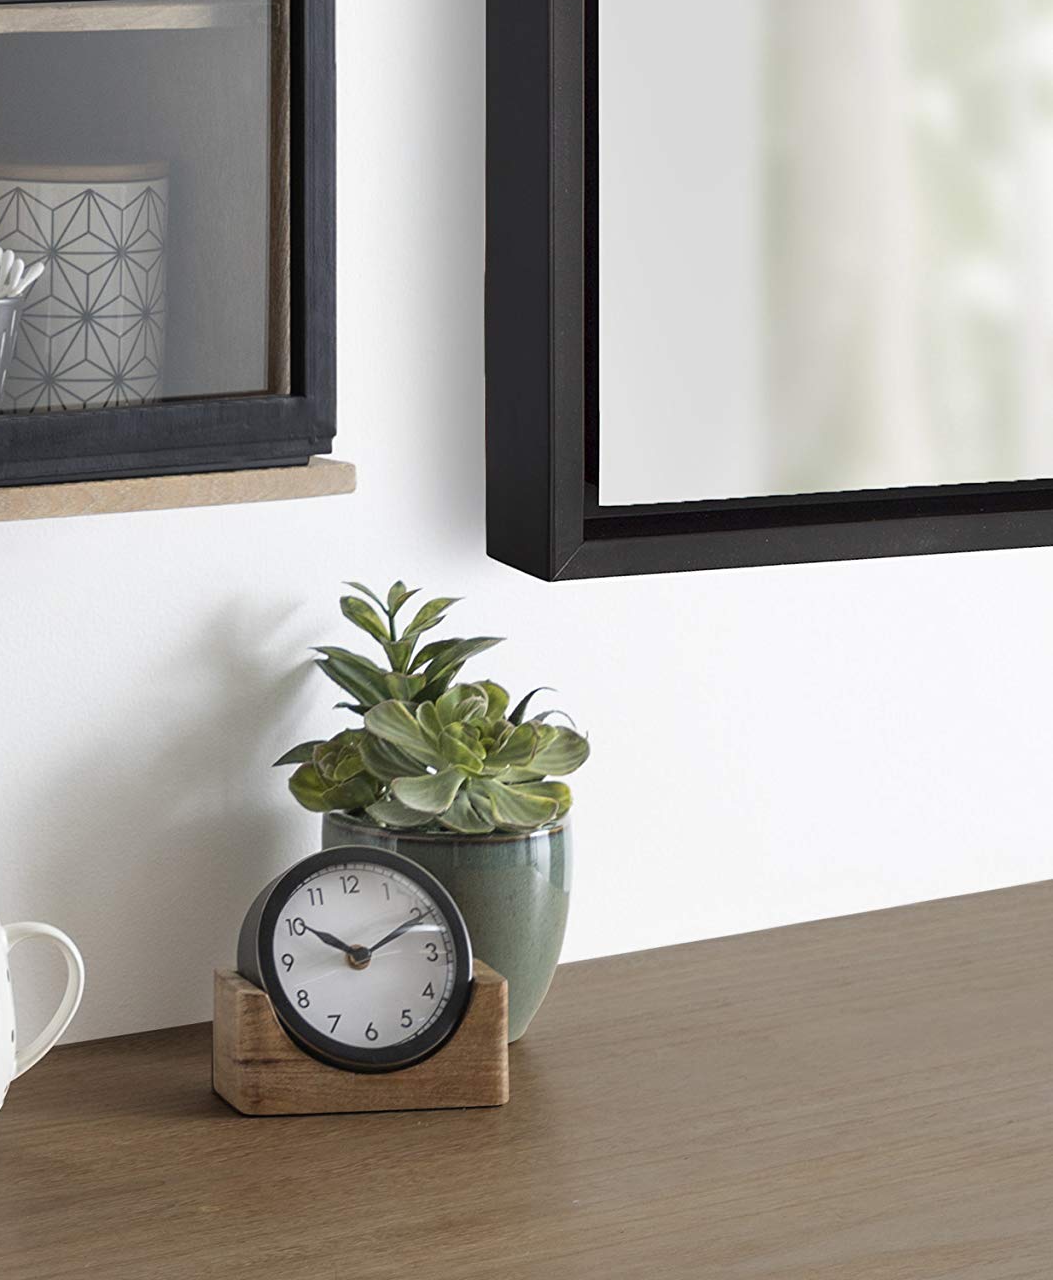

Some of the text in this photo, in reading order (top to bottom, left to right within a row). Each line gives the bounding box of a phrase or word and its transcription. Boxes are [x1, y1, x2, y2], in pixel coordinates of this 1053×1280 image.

[339, 875, 360, 894] 12
[382, 883, 390, 900] 1
[307, 887, 324, 906] 11
[409, 907, 424, 925] 2
[285, 917, 306, 936] 10
[424, 943, 439, 962] 3
[281, 953, 295, 972] 9
[296, 989, 311, 1009] 8
[421, 982, 435, 1000] 4
[327, 1014, 342, 1034] 7
[400, 1009, 414, 1028] 5
[364, 1022, 379, 1041] 6
